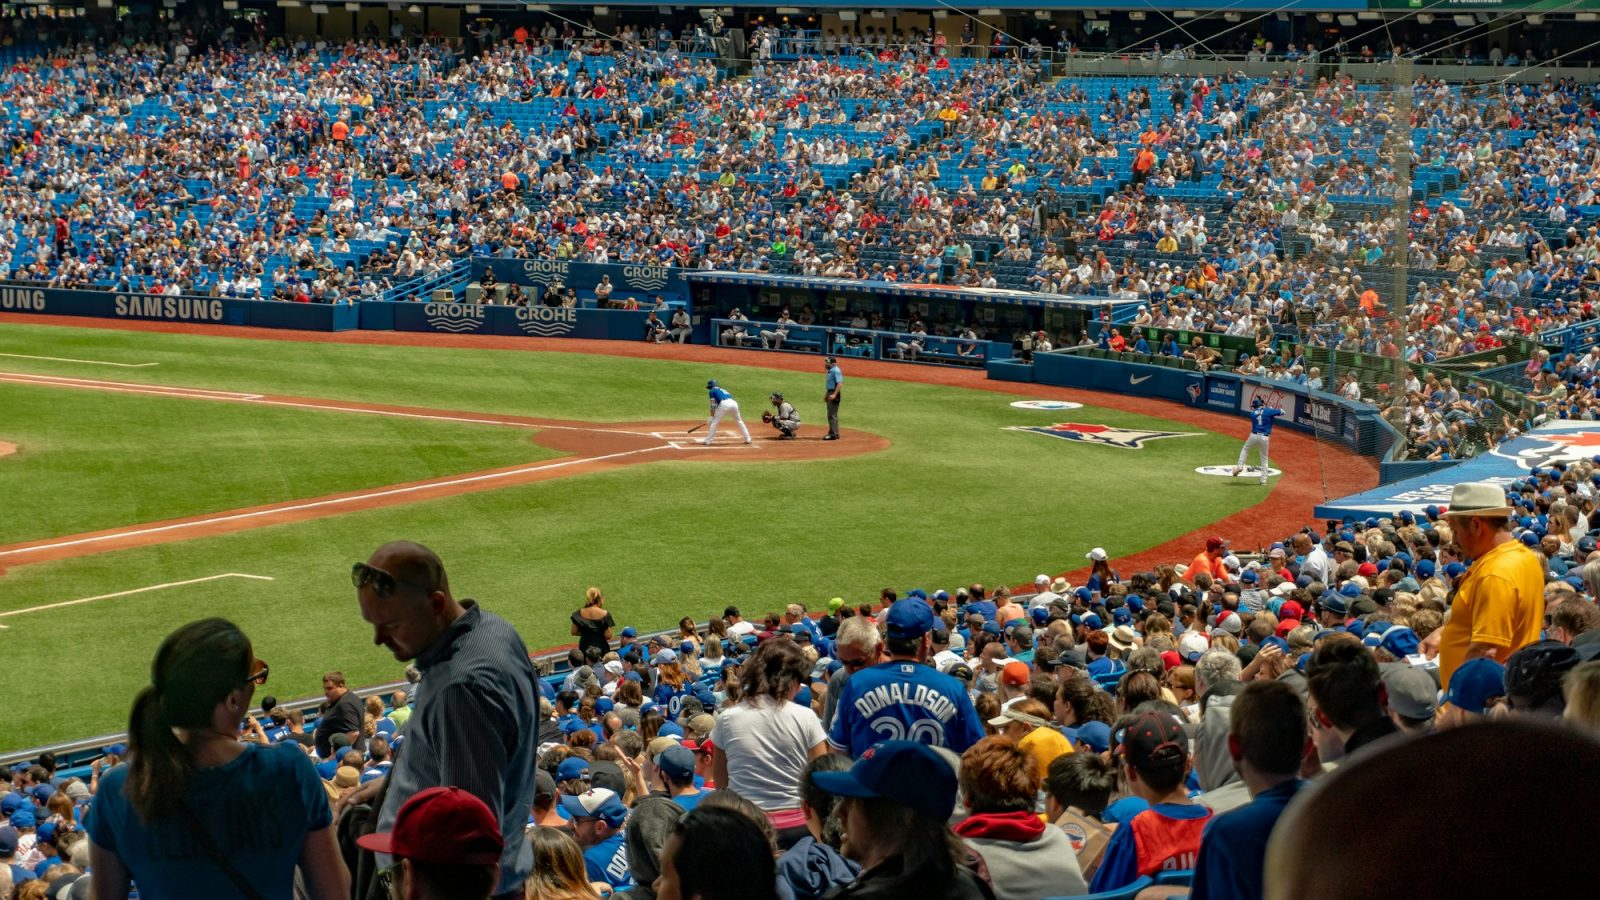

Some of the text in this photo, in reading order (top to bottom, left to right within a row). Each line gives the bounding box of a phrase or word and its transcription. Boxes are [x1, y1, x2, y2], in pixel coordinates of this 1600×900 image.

[524, 260, 569, 273] GROHE
[624, 266, 668, 280] GROHE
[115, 295, 223, 321] SAMSUNG
[424, 302, 485, 318] GROHE
[515, 306, 577, 323] GROHE
[854, 683, 957, 723] DONALDSON
[870, 716, 944, 747] 20
